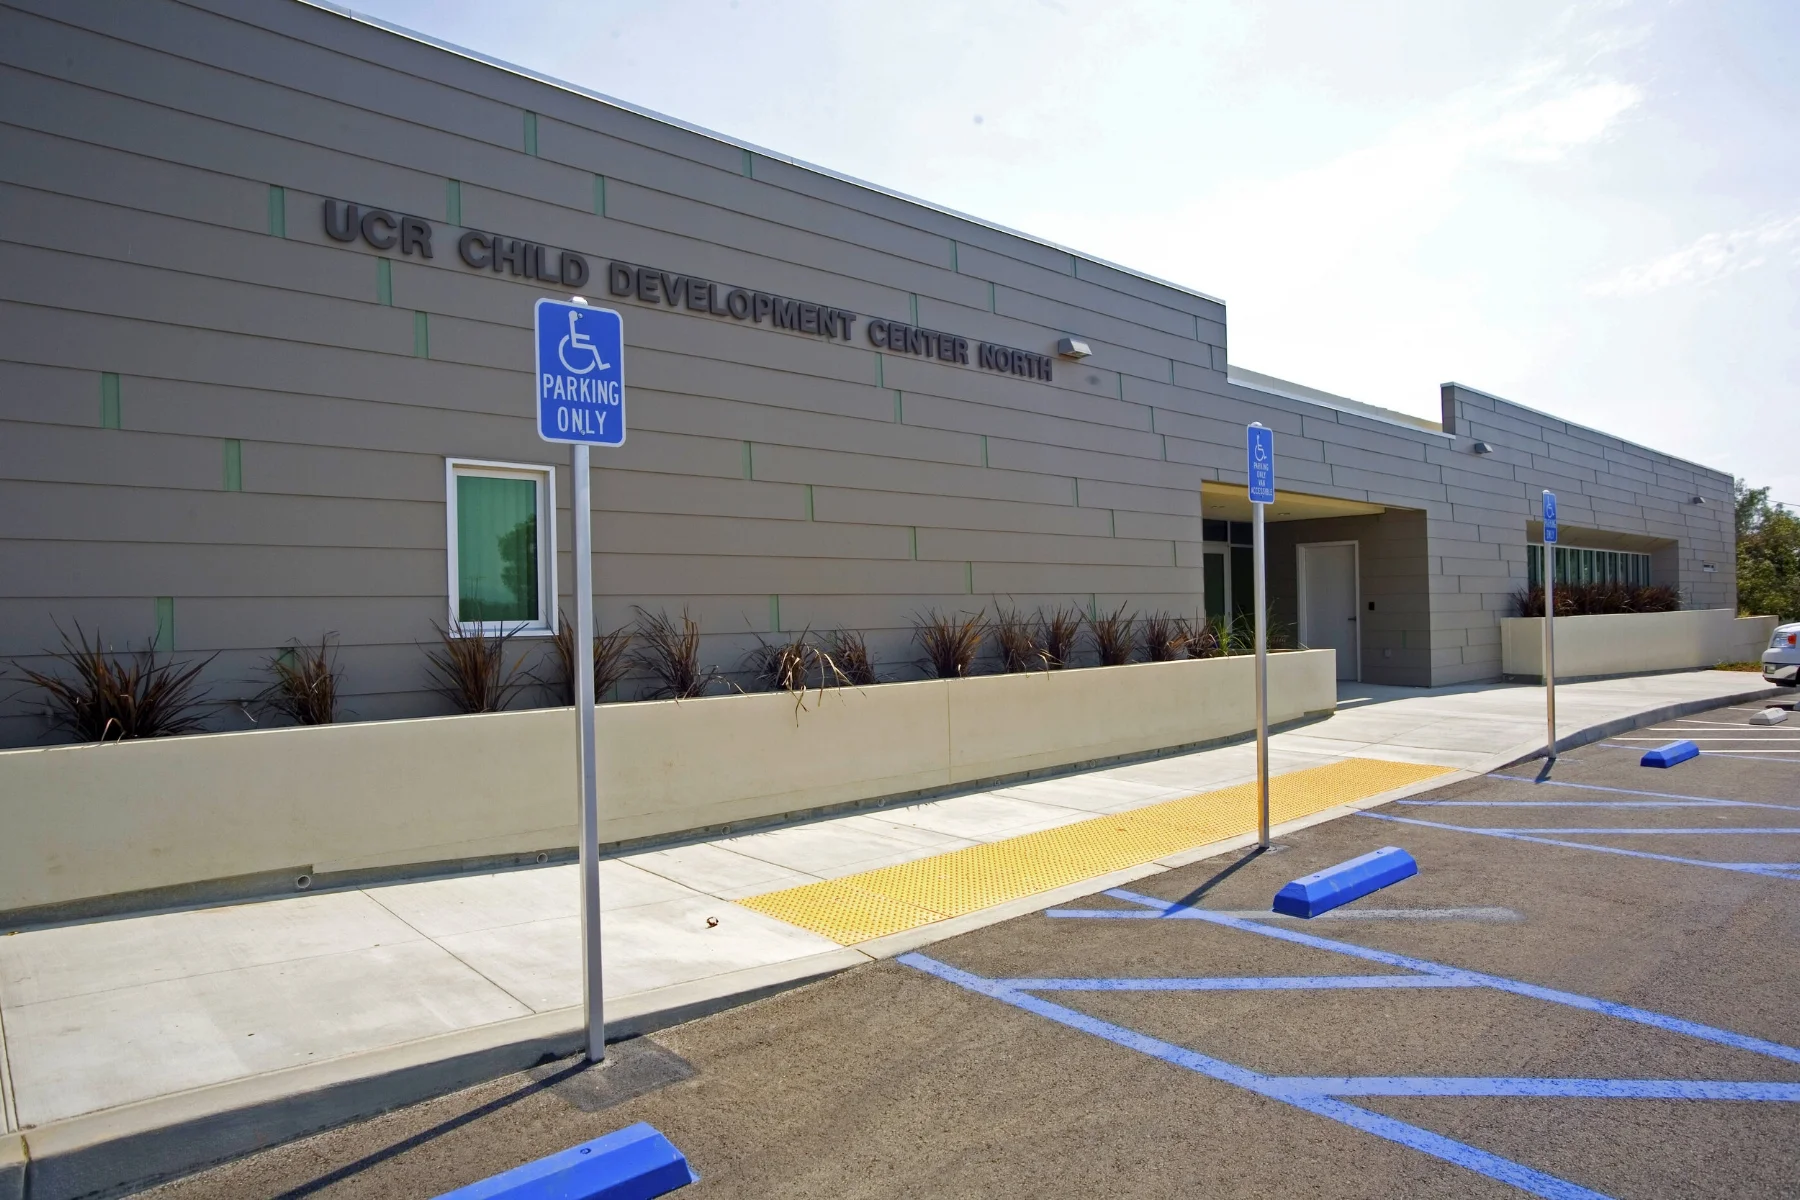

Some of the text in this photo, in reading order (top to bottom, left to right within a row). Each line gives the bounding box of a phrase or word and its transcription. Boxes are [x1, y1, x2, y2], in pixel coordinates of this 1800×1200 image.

[324, 199, 1053, 382] UCR CHILD DEVELOPMENT CENTER NORTH
[543, 373, 619, 406] PARKING
[557, 406, 607, 435] ONLY
[1253, 461, 1269, 472] PARKING
[1256, 470, 1267, 479] ONLY
[1251, 486, 1273, 496] ACCESSIBLE
